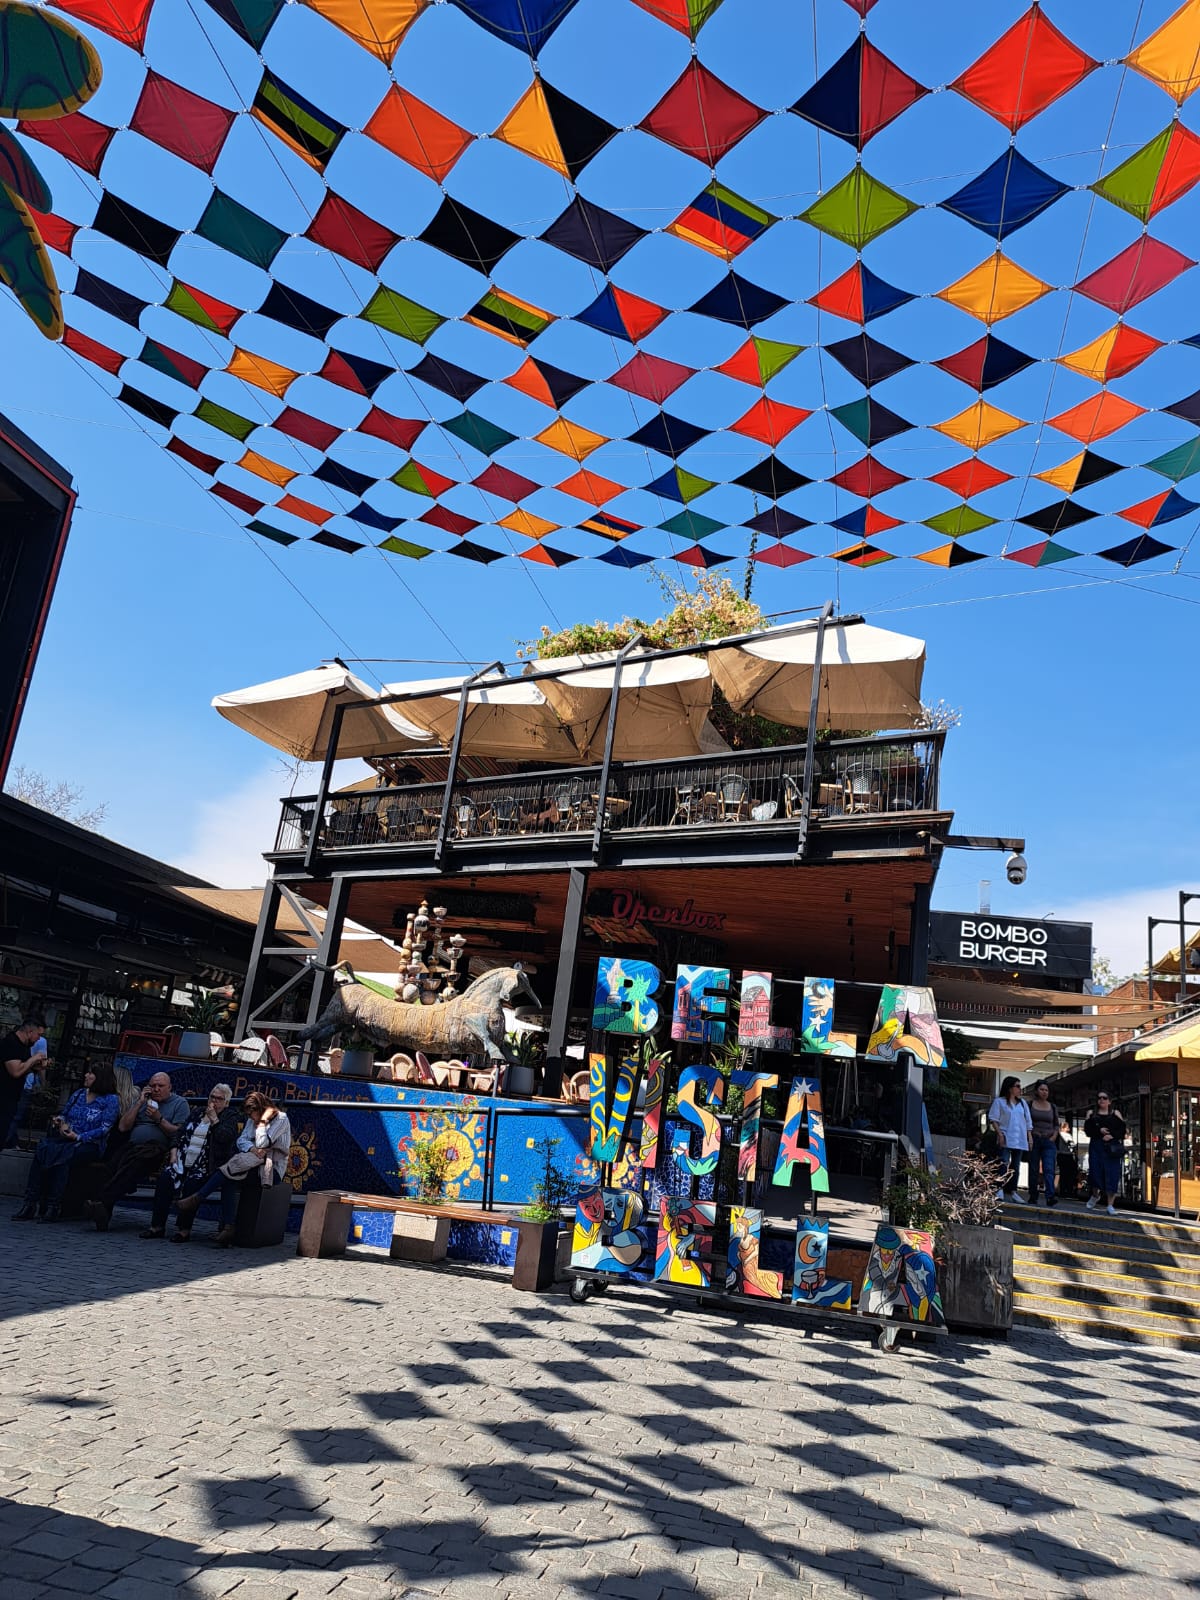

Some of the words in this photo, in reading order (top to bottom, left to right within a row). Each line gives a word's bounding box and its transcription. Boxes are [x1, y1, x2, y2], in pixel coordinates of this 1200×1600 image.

[611, 888, 727, 928] Openbox
[960, 920, 1048, 945] BOMBO
[959, 941, 1047, 967] BURGER
[592, 956, 948, 1068] BELLA
[234, 1076, 279, 1099] Patio
[588, 1052, 830, 1192] VISTA
[571, 1184, 946, 1324] BELLA
